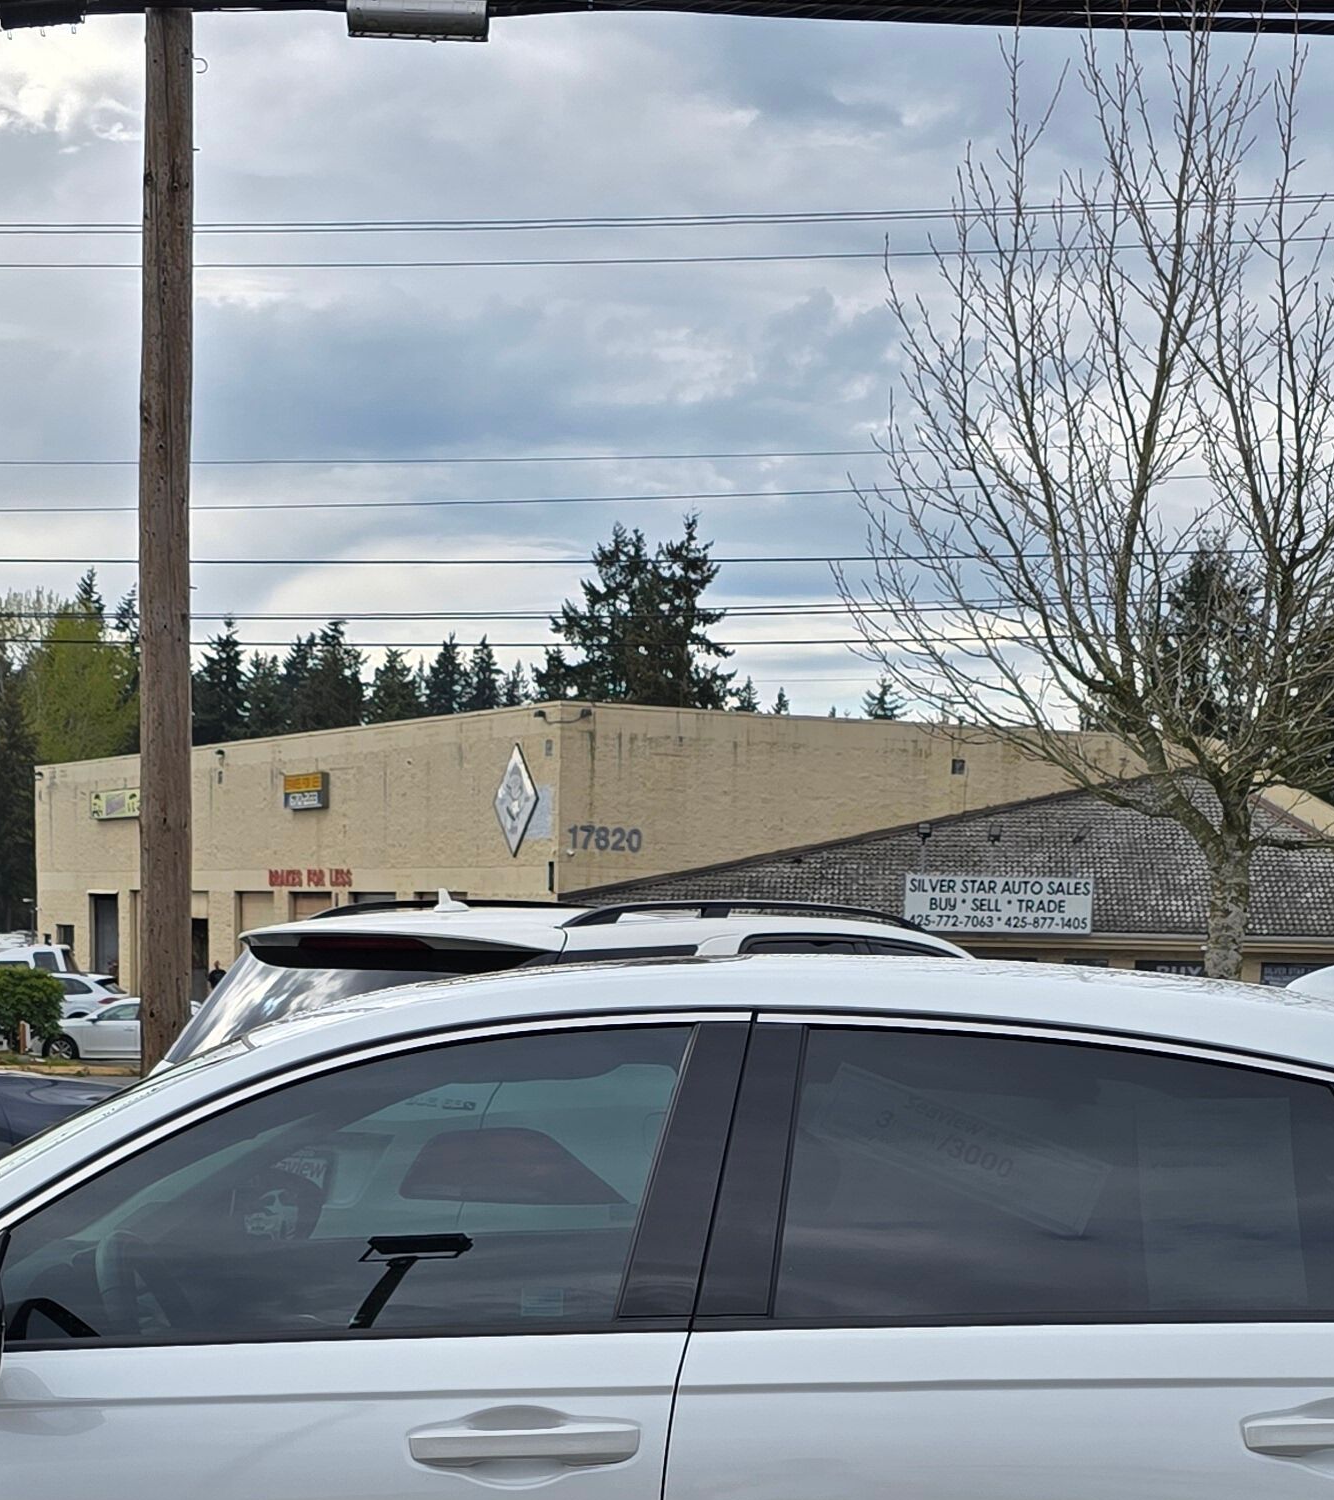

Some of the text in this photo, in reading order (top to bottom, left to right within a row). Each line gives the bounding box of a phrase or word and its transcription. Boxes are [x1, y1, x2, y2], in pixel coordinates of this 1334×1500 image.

[568, 824, 642, 853] 17820
[306, 868, 326, 888] FOR
[329, 868, 353, 888] LESS
[908, 878, 1091, 897] SILVER STAR AUTO SALES
[929, 897, 1066, 914] BUY SELL TRADE
[1004, 917, 1088, 930] 425-877-1405
